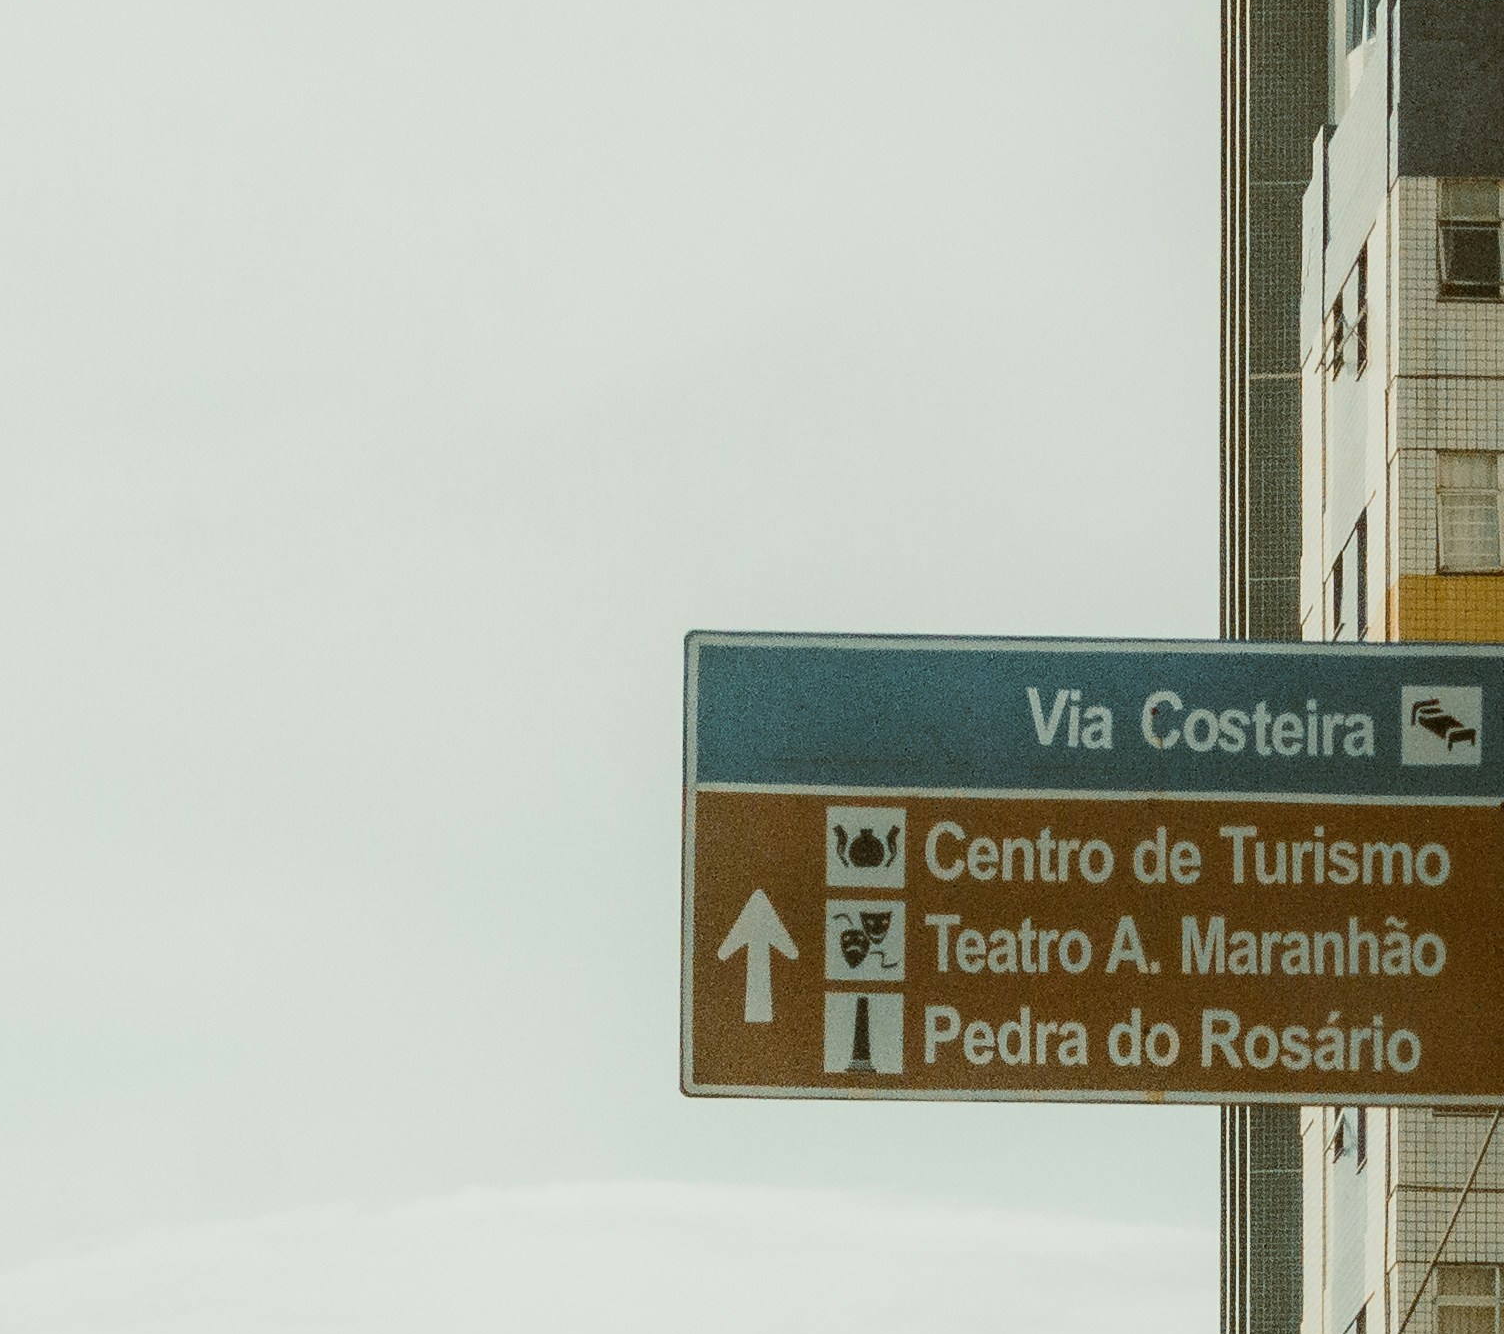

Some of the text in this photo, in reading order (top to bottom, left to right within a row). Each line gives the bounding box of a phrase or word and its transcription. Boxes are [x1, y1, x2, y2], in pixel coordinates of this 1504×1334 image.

[1027, 687, 1376, 757] Via Costeira
[923, 820, 1452, 888] Centro de Turismo
[925, 914, 1446, 979] Teatro A. Maranhão
[923, 1007, 1422, 1073] Pedra do Rosário
